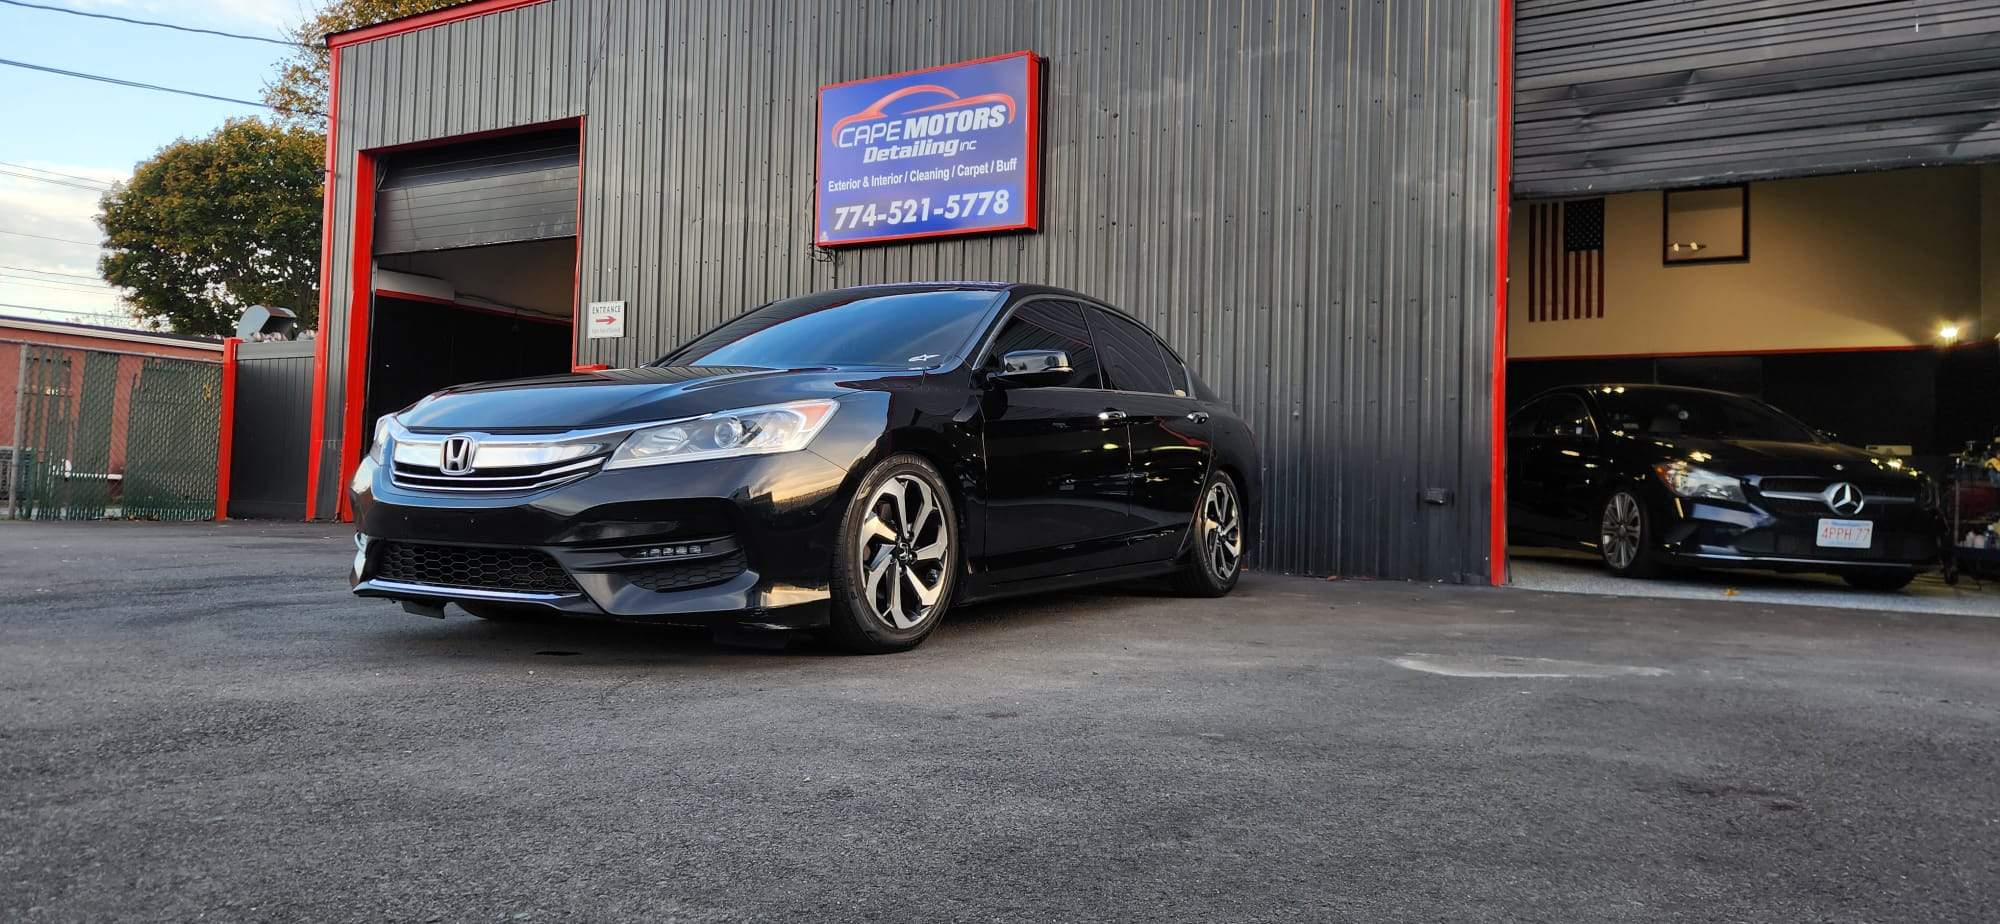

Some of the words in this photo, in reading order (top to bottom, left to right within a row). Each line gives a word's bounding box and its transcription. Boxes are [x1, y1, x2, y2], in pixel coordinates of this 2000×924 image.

[838, 120, 903, 148] CAPE
[903, 104, 1007, 140] MOTORS
[863, 139, 960, 164] Detailing
[828, 178, 862, 193] Exterior
[862, 175, 870, 188] &
[871, 172, 904, 187] Interior
[909, 167, 950, 182] Cleaning
[957, 161, 989, 178] Carpet
[996, 157, 1018, 173] Buff
[834, 189, 1010, 231] 774-521-5778
